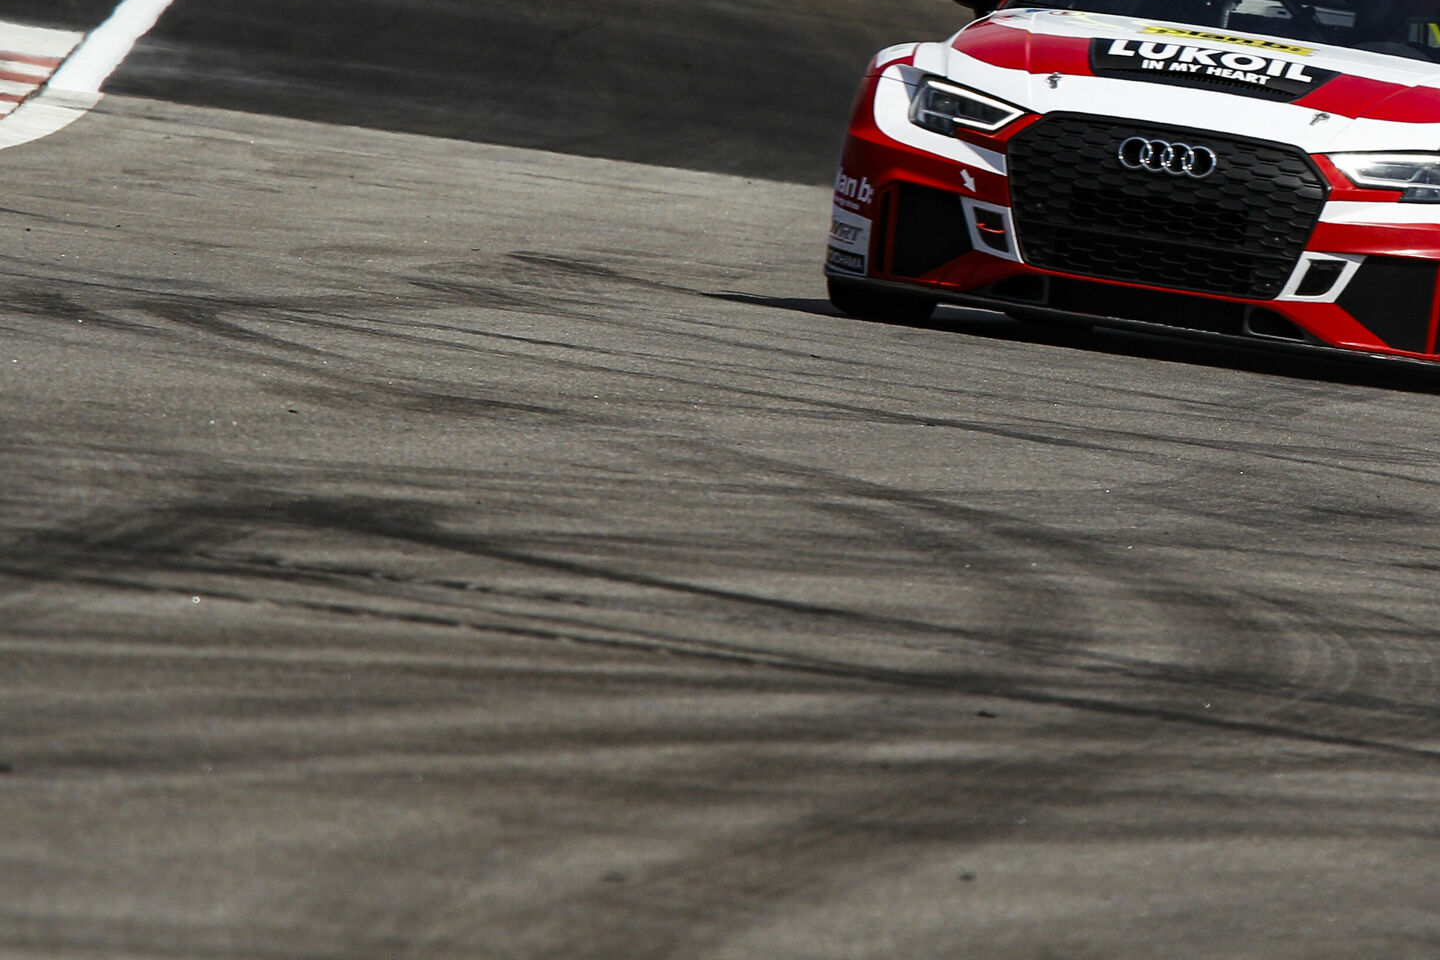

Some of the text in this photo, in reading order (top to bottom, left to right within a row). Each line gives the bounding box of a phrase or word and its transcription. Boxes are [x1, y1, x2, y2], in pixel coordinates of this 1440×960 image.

[1107, 39, 1313, 83] LUKOIL
[1141, 59, 1271, 86] IN MY HEART
